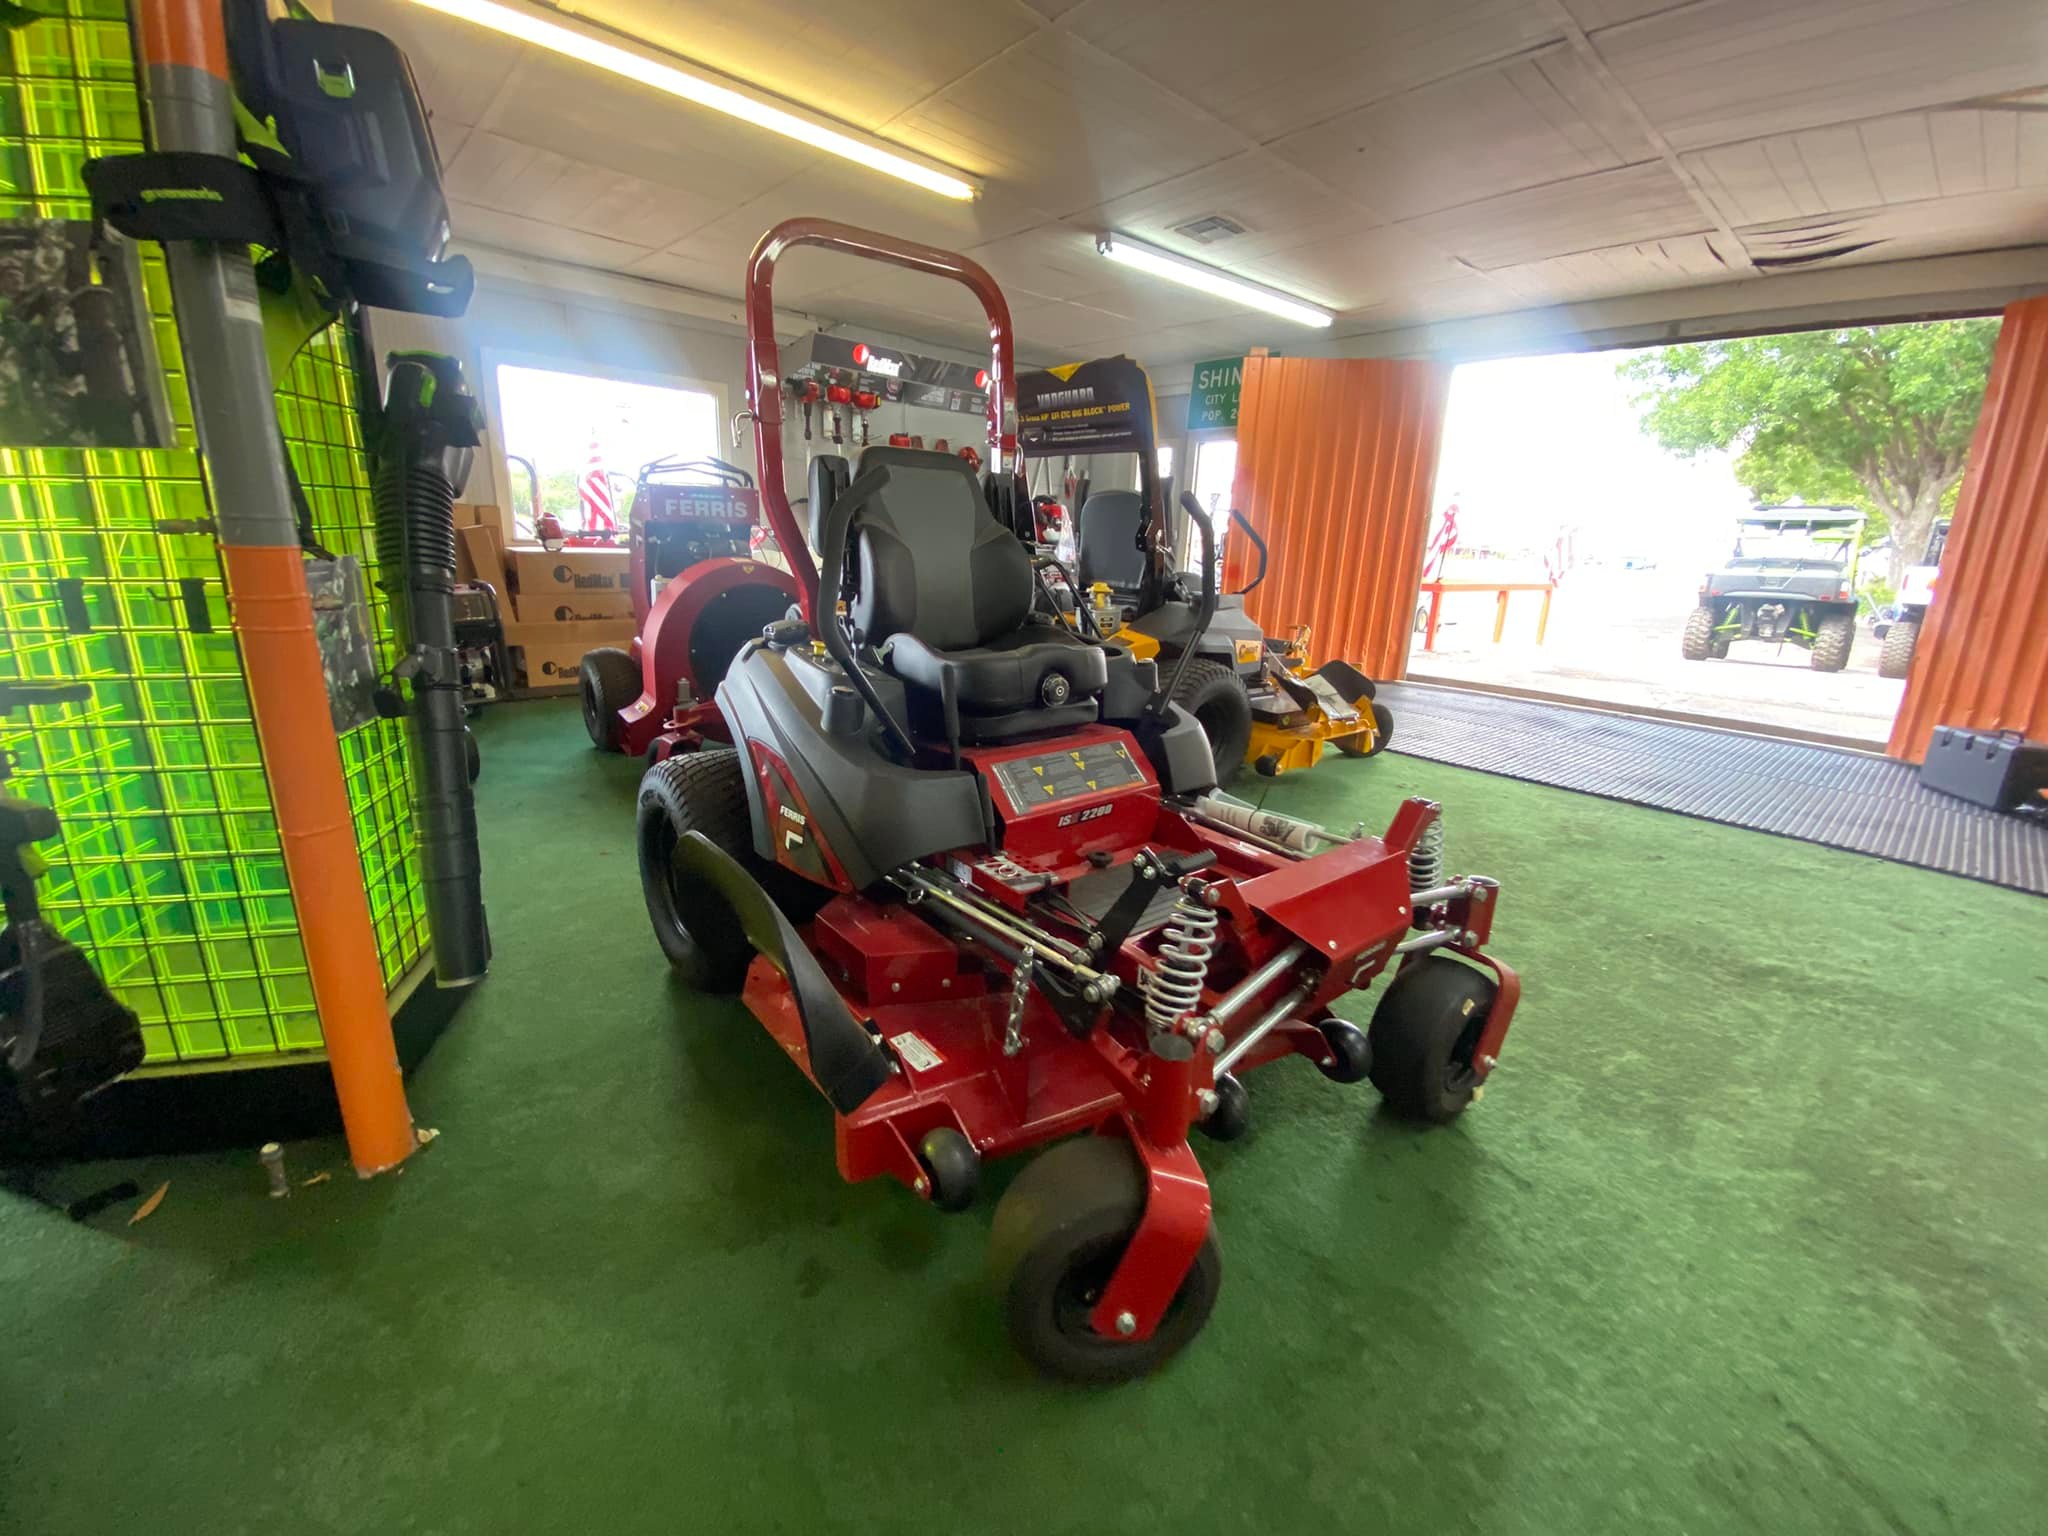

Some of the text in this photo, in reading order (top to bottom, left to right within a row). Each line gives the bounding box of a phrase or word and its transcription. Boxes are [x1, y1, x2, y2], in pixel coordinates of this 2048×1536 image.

[1037, 386, 1095, 409] VANGUARD
[1205, 393, 1226, 405] CITY
[1107, 402, 1131, 413] POWER
[665, 499, 748, 518] FERRIS
[780, 804, 806, 825] FERRIS
